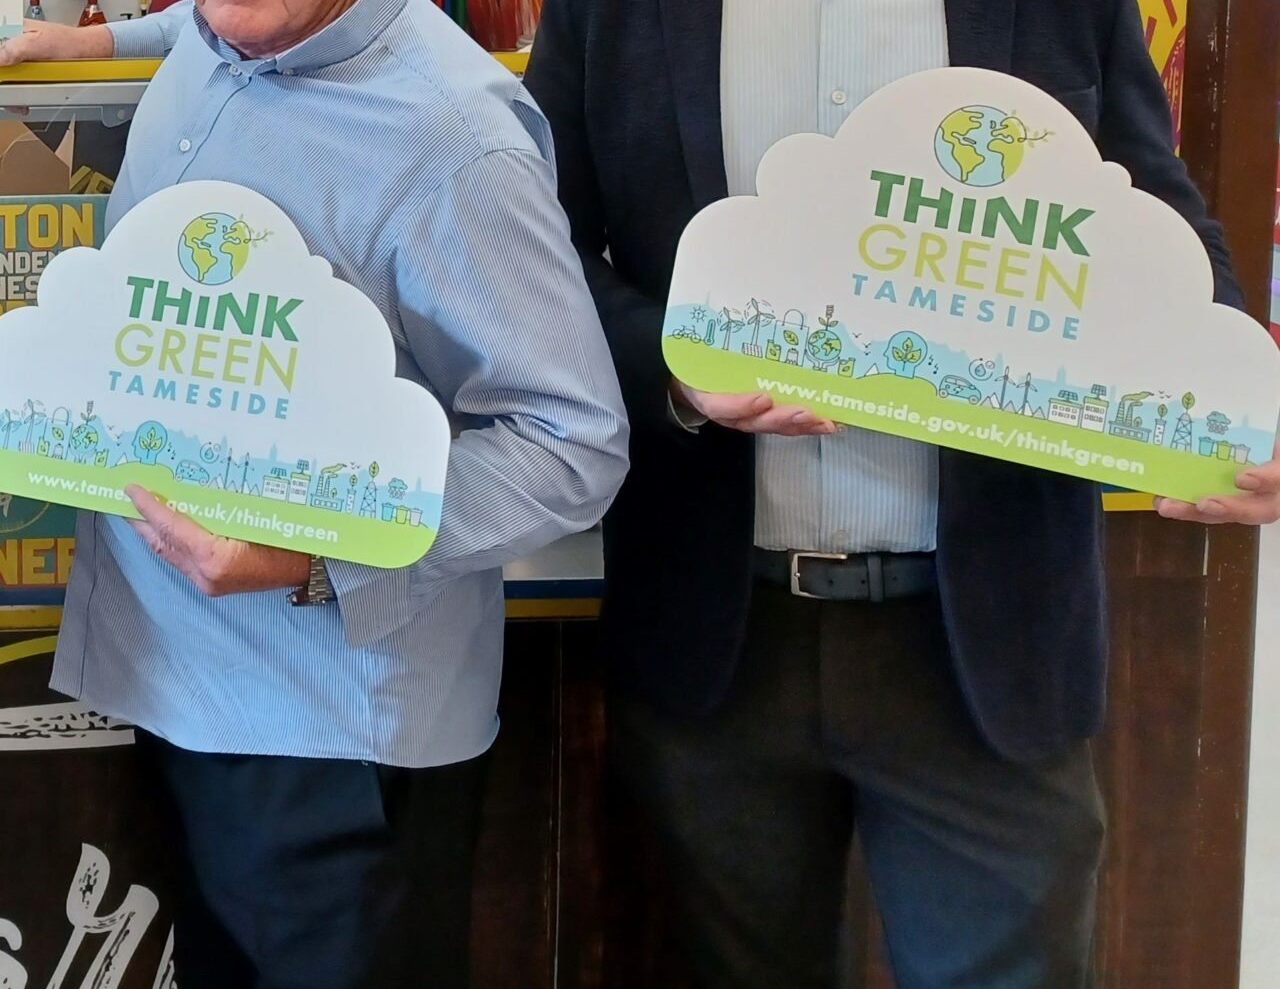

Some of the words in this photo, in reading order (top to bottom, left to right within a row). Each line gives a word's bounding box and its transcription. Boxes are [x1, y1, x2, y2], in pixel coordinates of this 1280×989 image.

[858, 223, 1089, 310] GREEN
[851, 273, 1080, 340] TAMESIDE
[114, 323, 298, 392] GREEN
[108, 371, 290, 420] TAMESIDE
[755, 374, 1145, 476] www.tameside.gov.uk/thinkgreen
